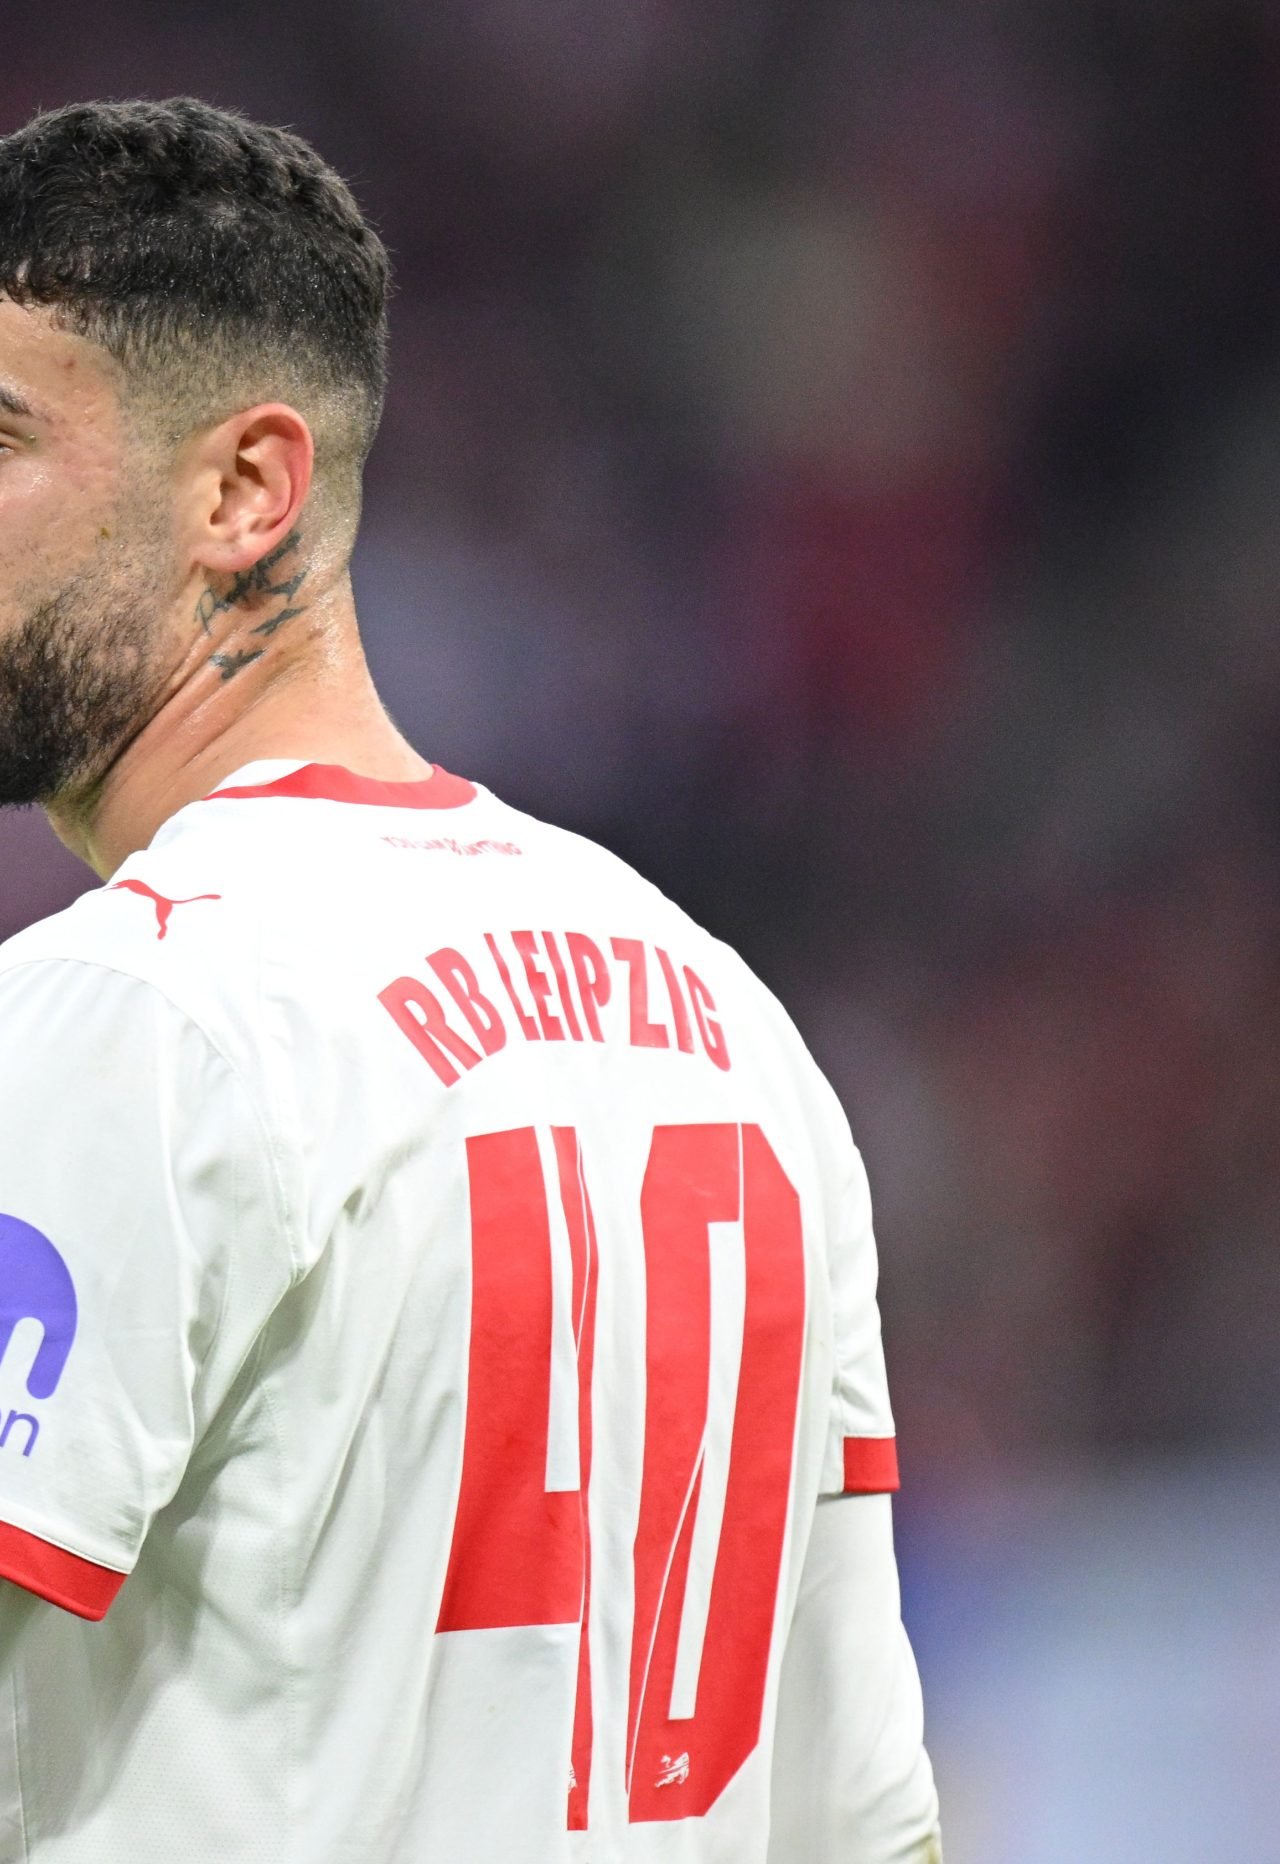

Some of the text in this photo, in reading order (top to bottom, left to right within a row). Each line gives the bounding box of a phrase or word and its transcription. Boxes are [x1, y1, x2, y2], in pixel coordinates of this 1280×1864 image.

[377, 930, 731, 1089] RB LEIPZIG
[434, 1123, 806, 1831] 40
